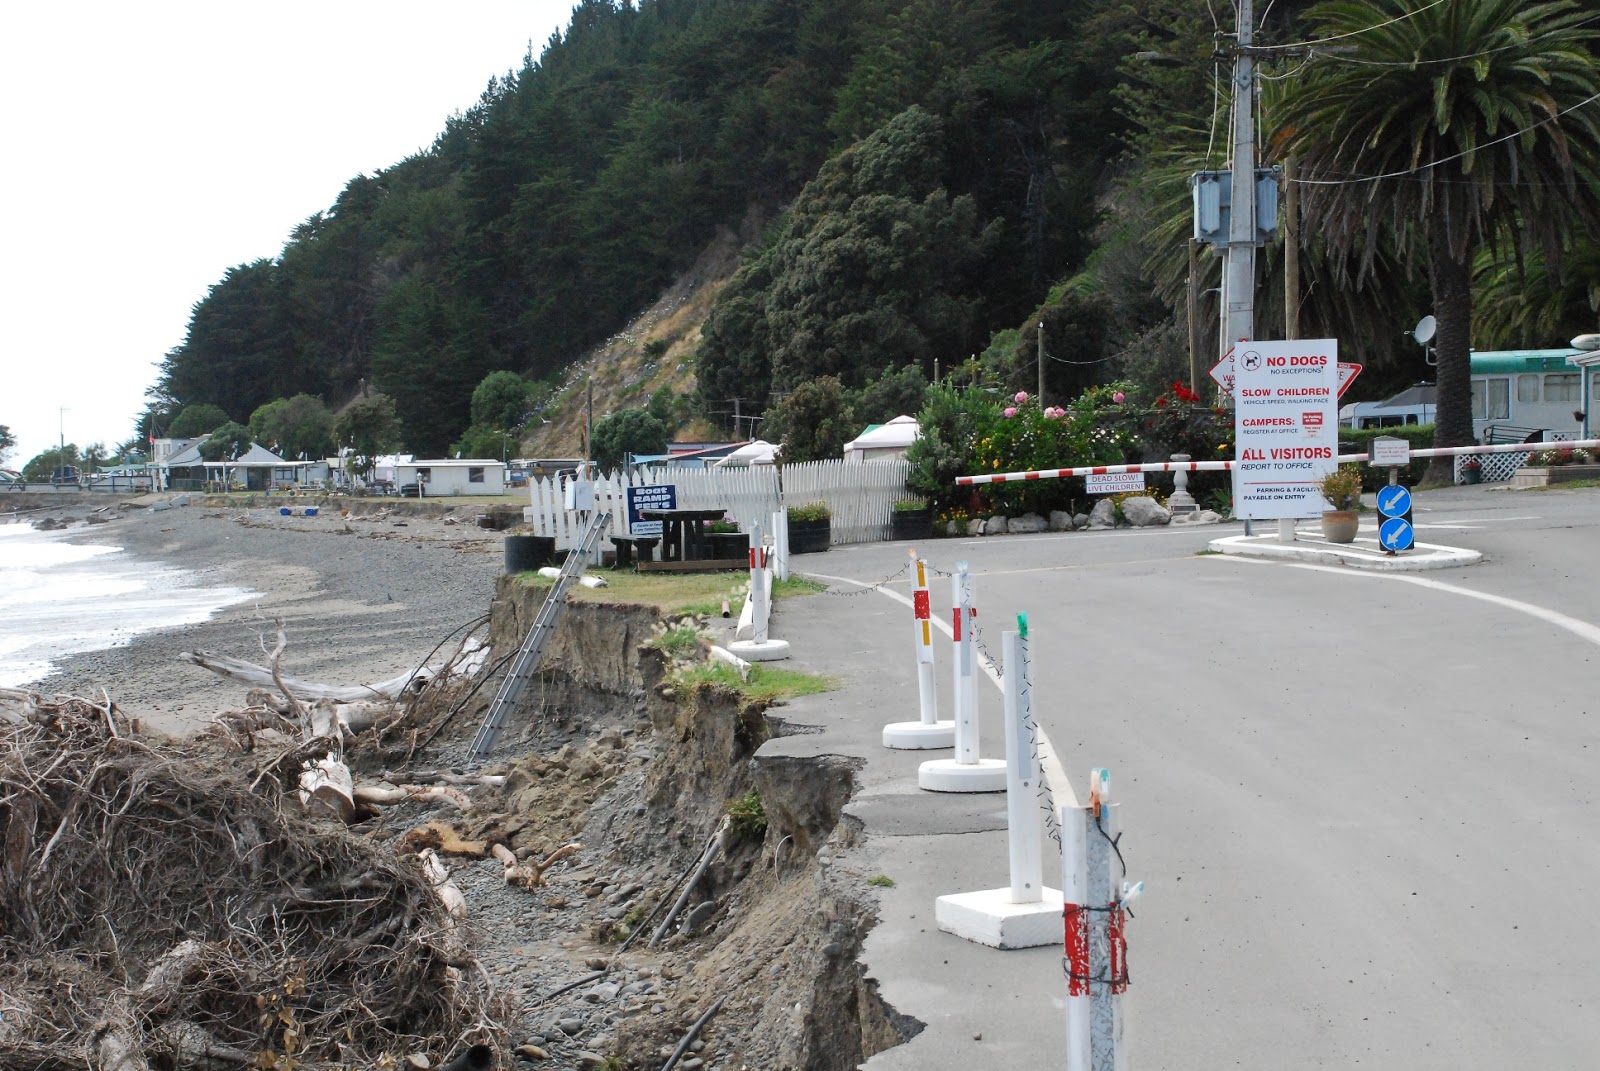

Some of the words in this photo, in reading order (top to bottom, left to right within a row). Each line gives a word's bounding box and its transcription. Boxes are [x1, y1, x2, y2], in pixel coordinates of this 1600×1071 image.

[1266, 357, 1286, 366] NO
[1290, 356, 1328, 366] DOGS
[1277, 388, 1330, 396] CHILDREN
[1242, 418, 1295, 427] CAMPERS:
[1242, 449, 1266, 460] ALL
[1270, 447, 1332, 460] VISITORS
[633, 495, 670, 503] RAMP
[635, 502, 670, 510] FEE'S
